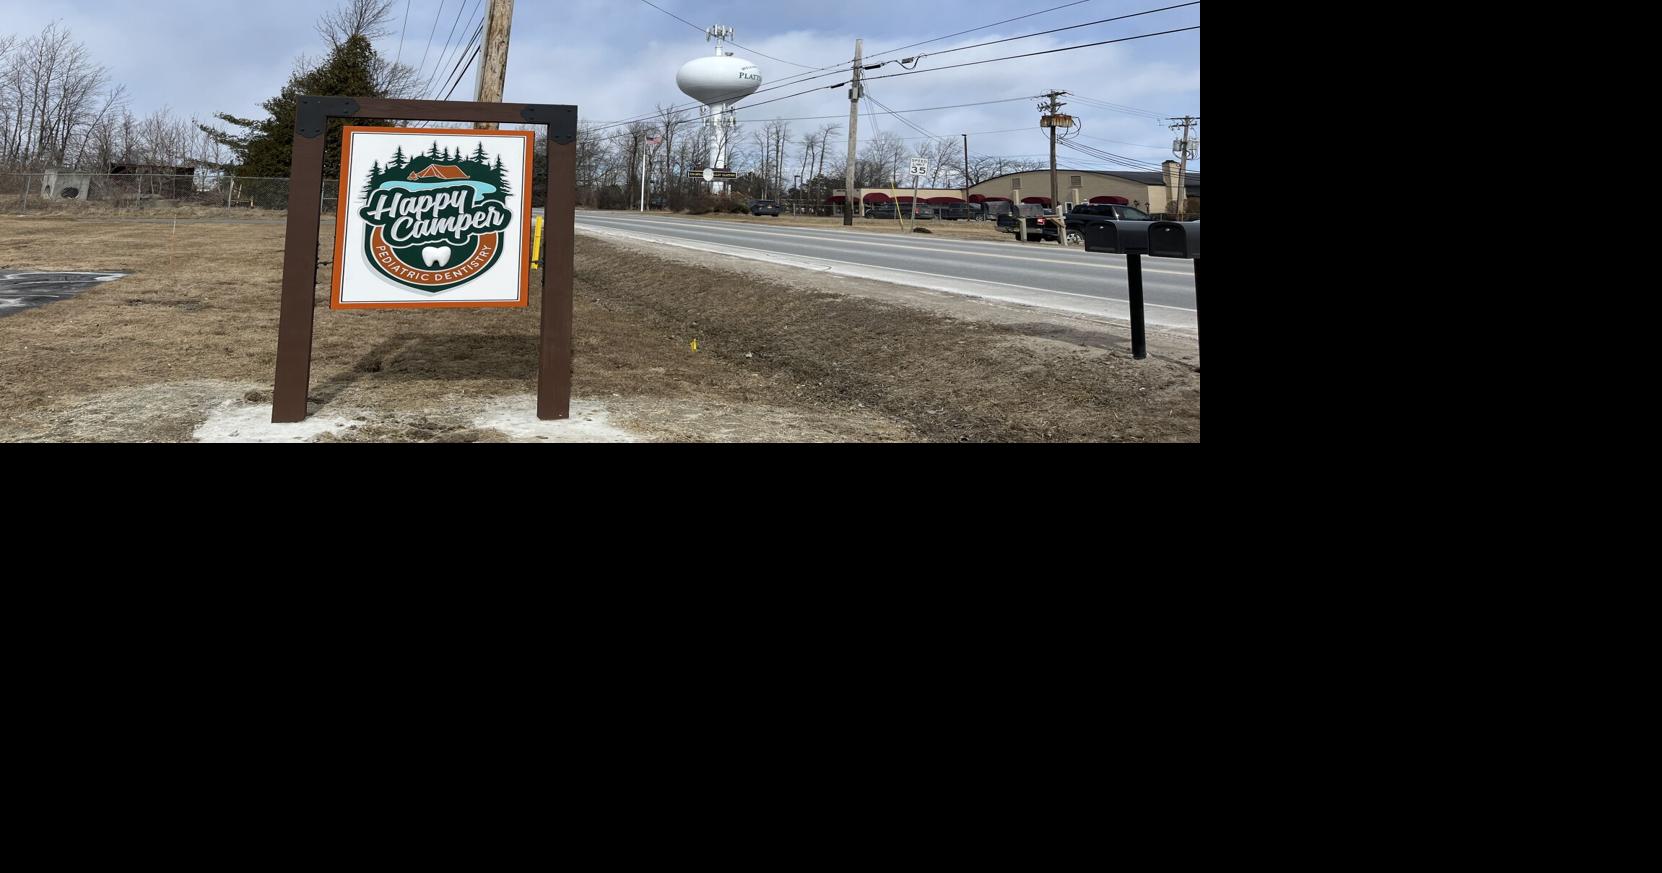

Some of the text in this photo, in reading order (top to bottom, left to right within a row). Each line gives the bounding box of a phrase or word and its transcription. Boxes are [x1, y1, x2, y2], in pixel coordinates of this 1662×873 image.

[911, 166, 926, 174] 35
[367, 190, 467, 220] Happy
[391, 206, 504, 241] Camper
[376, 245, 491, 281] PEDIATRIC DENTISTRY
